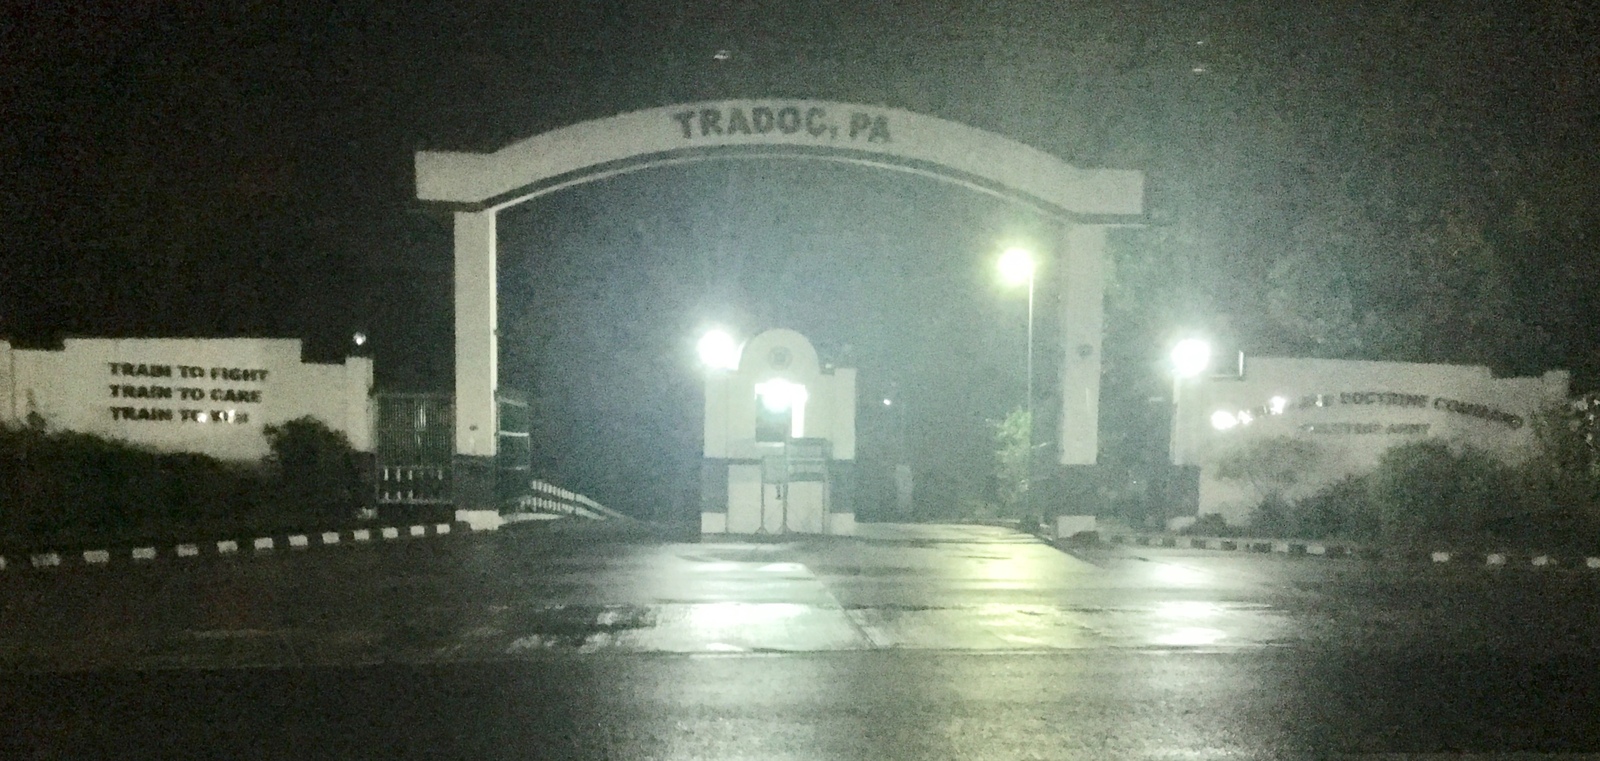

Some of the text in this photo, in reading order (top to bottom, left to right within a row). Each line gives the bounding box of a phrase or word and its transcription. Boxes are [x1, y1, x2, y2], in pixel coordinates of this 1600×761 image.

[673, 106, 892, 144] TRADOC, PA
[108, 361, 268, 382] TRAIN TO FIGHT
[109, 383, 262, 403] TRAIN TO CARE
[1340, 391, 1430, 408] DOCTRINE
[109, 405, 173, 421] TRAIN
